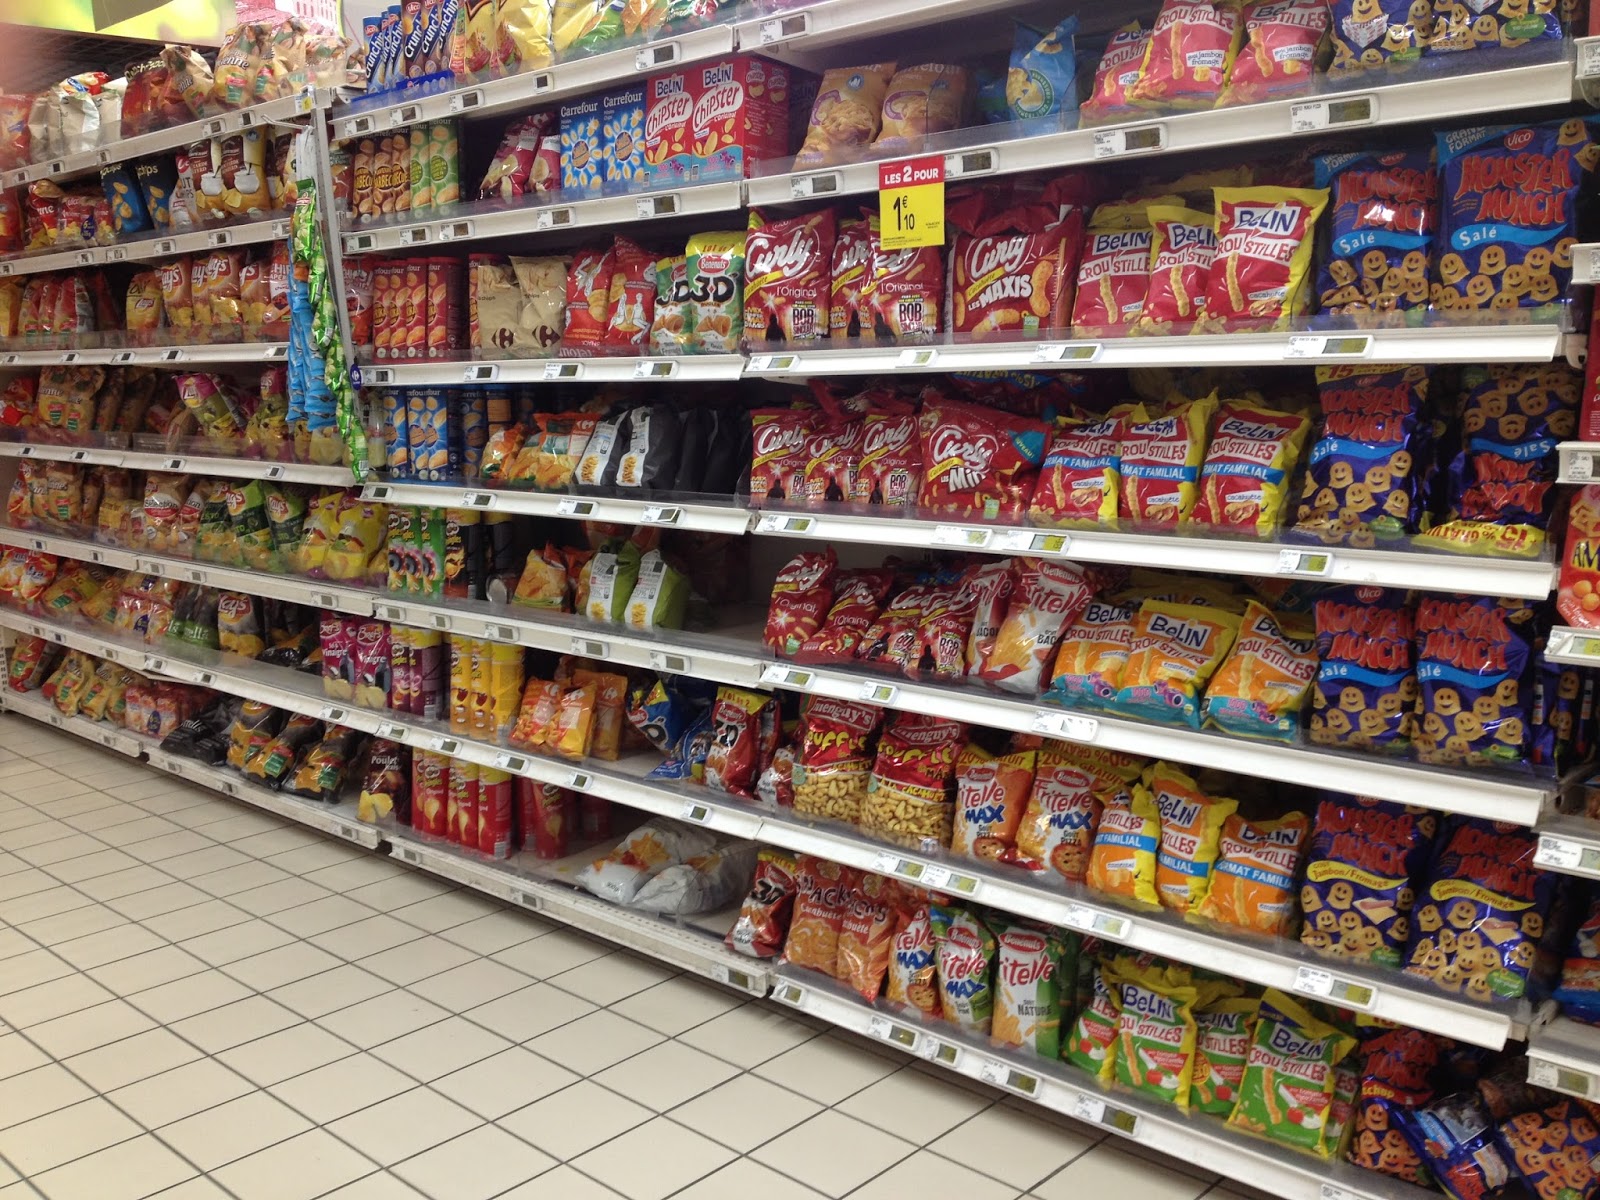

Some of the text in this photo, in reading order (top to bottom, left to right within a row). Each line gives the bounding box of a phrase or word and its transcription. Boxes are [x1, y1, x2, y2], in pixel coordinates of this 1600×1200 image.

[561, 101, 598, 117] Carrefour
[603, 91, 642, 108] Carrefour
[884, 165, 939, 185] LES 2 POUR
[1453, 150, 1574, 200] MONSTER
[1475, 190, 1567, 226] MUNCH
[904, 213, 915, 231] 10
[1340, 233, 1376, 254] Salé
[1459, 226, 1497, 247] Salé
[746, 230, 813, 278] Curly
[832, 235, 871, 277] Cur
[971, 233, 1030, 279] Curly
[979, 275, 1033, 309] MAXIS
[793, 308, 815, 325] BOB
[899, 303, 922, 322] BOB
[1313, 439, 1339, 460] Salé
[1070, 457, 1111, 468] FAMILIAL
[1145, 466, 1186, 479] FAMILIAL
[1223, 464, 1269, 480] FAMILIAL
[960, 783, 1004, 809] itelle
[965, 805, 1005, 824] MAX
[1050, 810, 1093, 830] MAX
[1103, 834, 1142, 847] FAMILIAL
[1252, 870, 1293, 888] FAMILIA
[1001, 953, 1056, 987] itelle
[1017, 1004, 1052, 1017] NATURE
